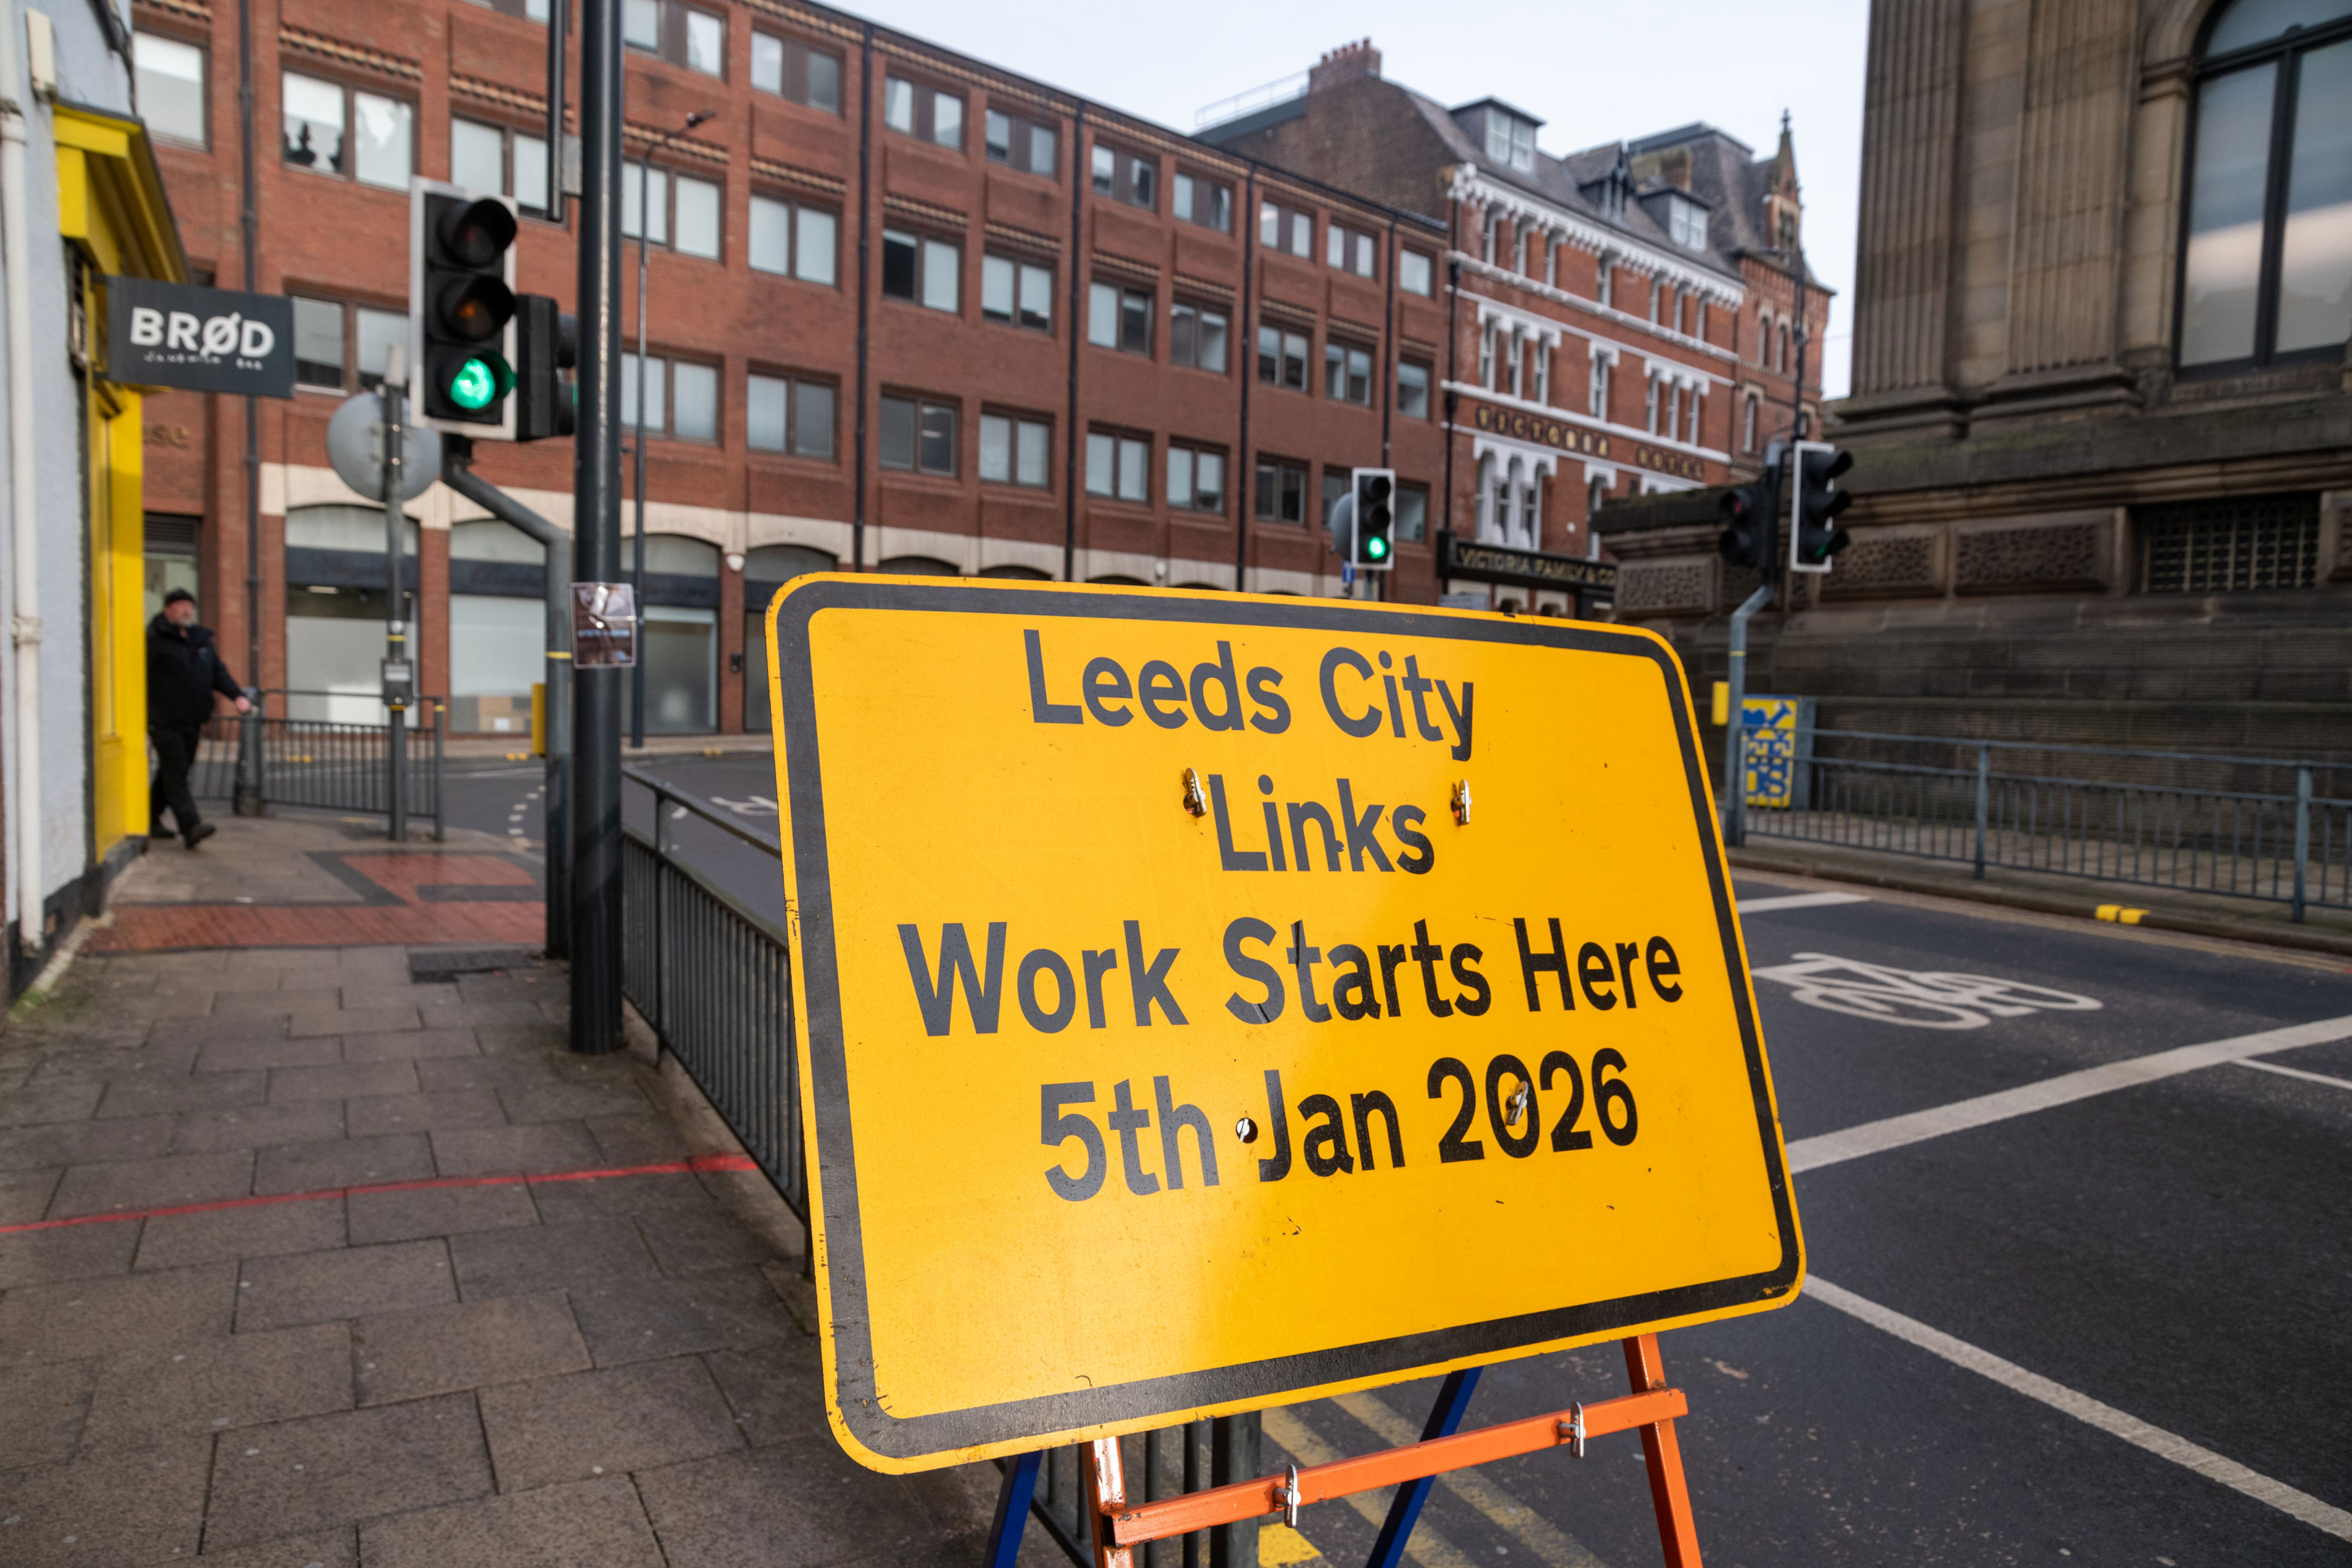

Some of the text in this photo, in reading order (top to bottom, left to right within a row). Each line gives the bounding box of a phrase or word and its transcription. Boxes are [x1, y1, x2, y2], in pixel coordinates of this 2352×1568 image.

[130, 306, 275, 358] BRØD
[1459, 547, 1531, 573] VICTORIA
[1024, 630, 1473, 761] Leeds City
[1208, 773, 1434, 874] Links
[898, 918, 1683, 1036] Work Starts Here
[1041, 1048, 1638, 1201] 5th Jan 2026
